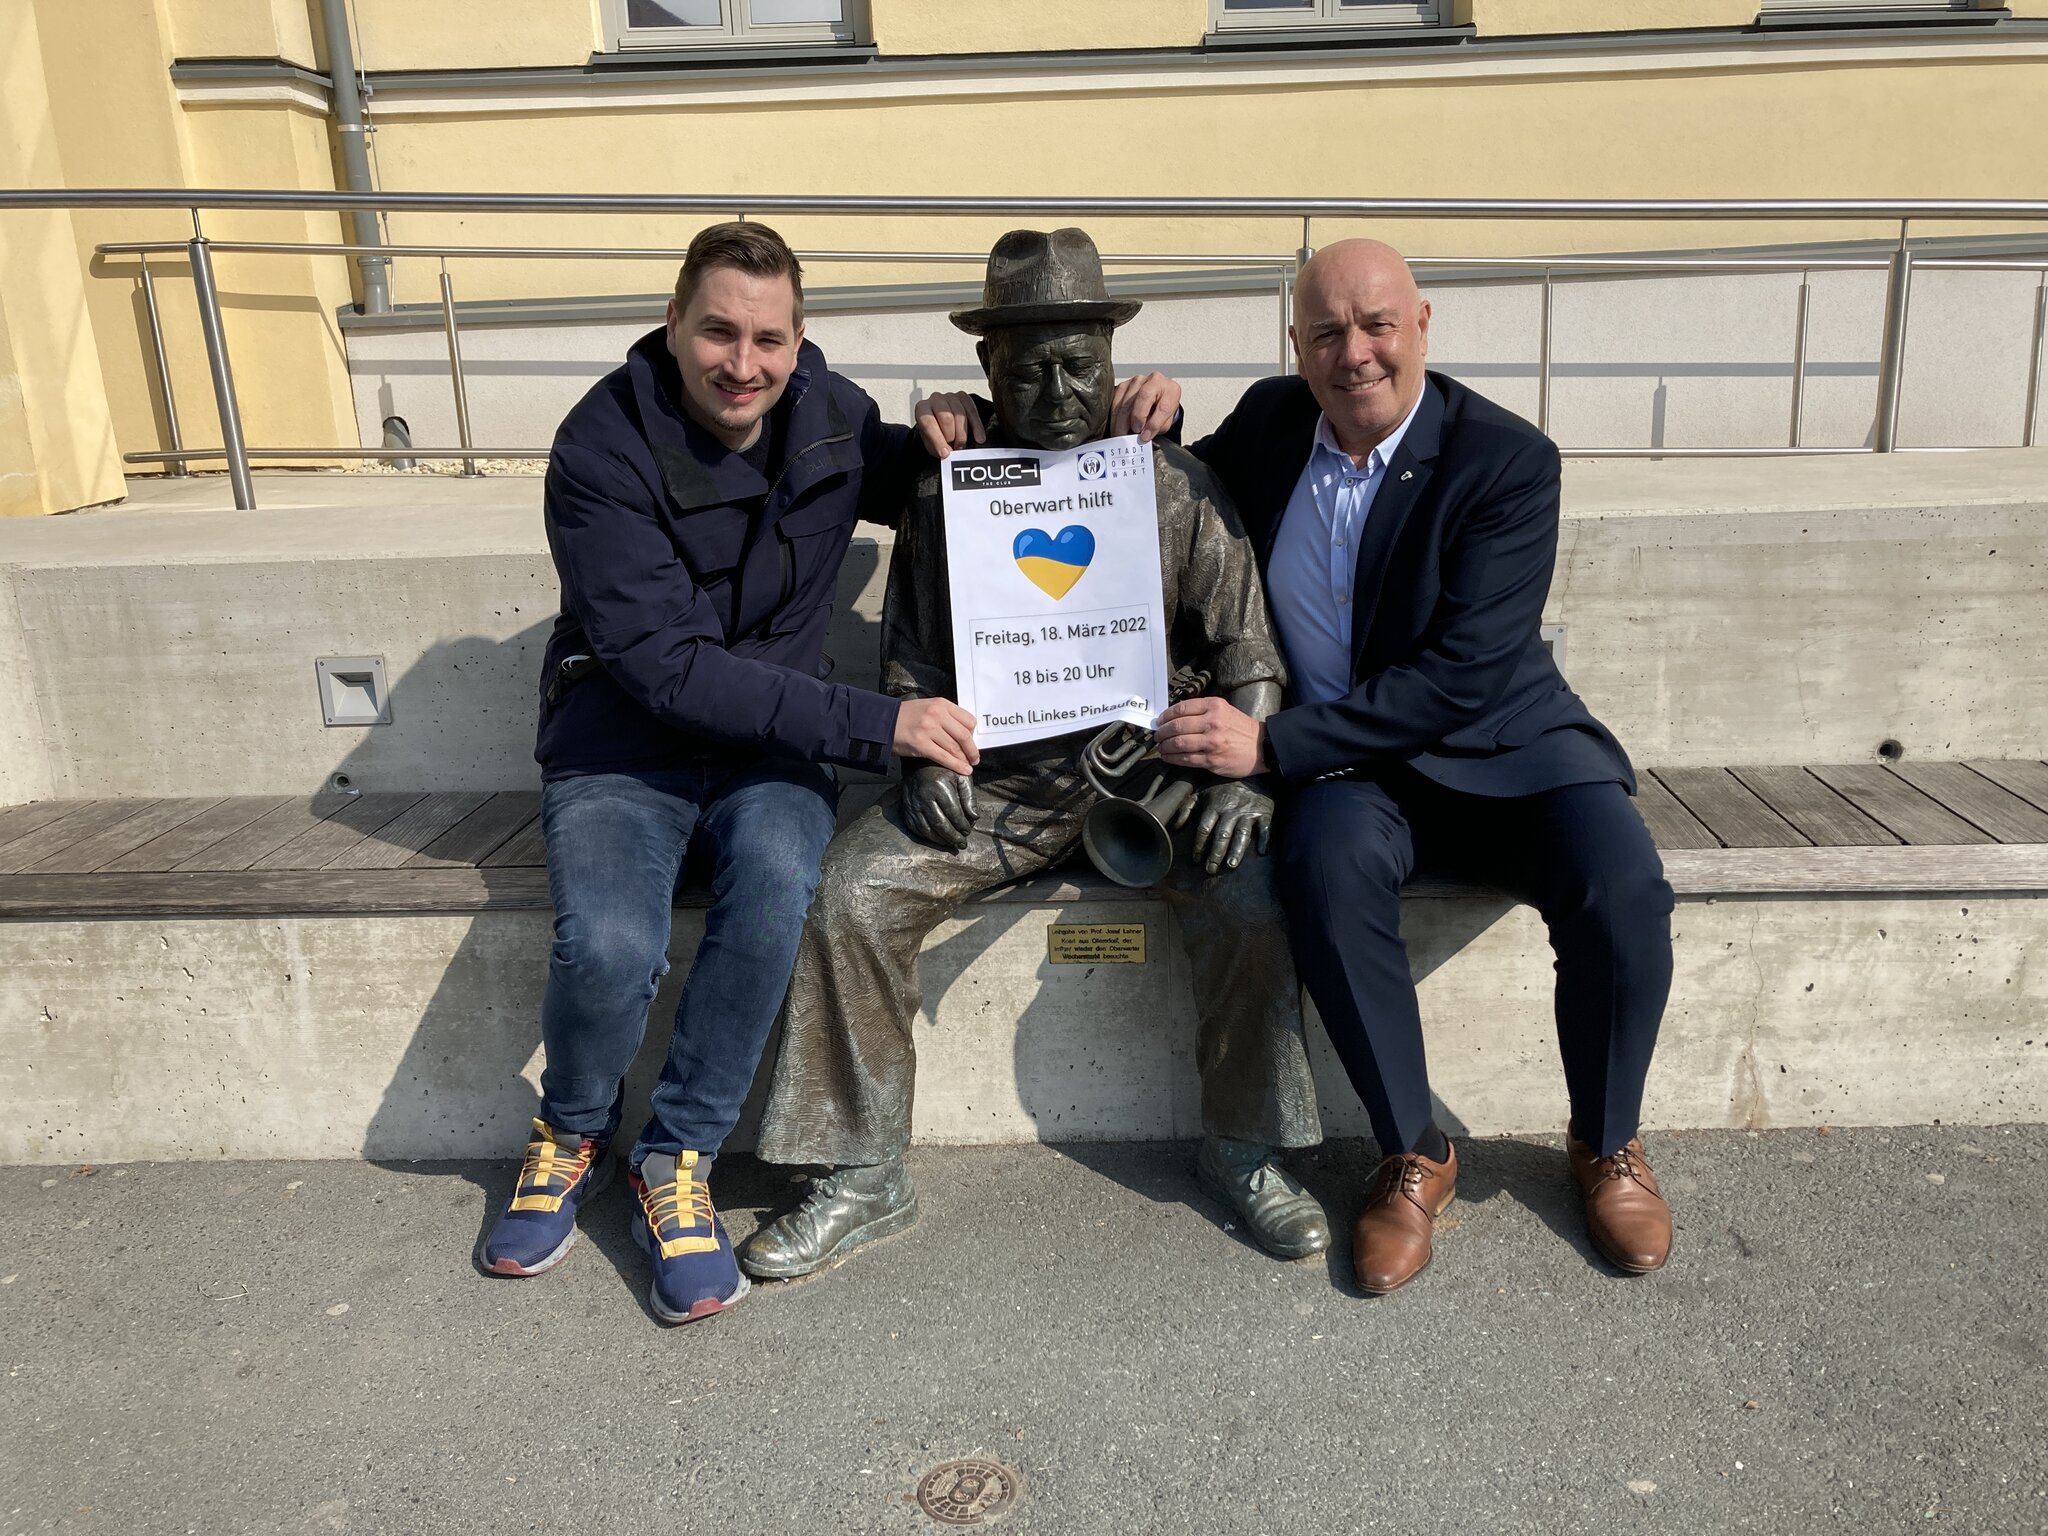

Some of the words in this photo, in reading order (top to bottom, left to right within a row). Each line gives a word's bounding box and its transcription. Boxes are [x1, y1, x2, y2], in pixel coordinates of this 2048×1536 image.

[1110, 446, 1144, 457] STADT
[953, 463, 1038, 482] TOUCH
[990, 495, 1073, 516] Oberwart
[1078, 491, 1113, 509] hilft
[974, 629, 1036, 647] Freitag,
[1040, 626, 1063, 641] 18.
[1067, 623, 1106, 639] März
[1110, 616, 1147, 634] 2022
[1013, 670, 1032, 685] 18
[1036, 669, 1059, 683] bis
[1063, 666, 1082, 682] 20
[1086, 664, 1115, 679] Uhr
[983, 710, 1024, 727] Touch
[1027, 705, 1077, 725] (Linkes
[1080, 698, 1150, 717] Pinkaufer)
